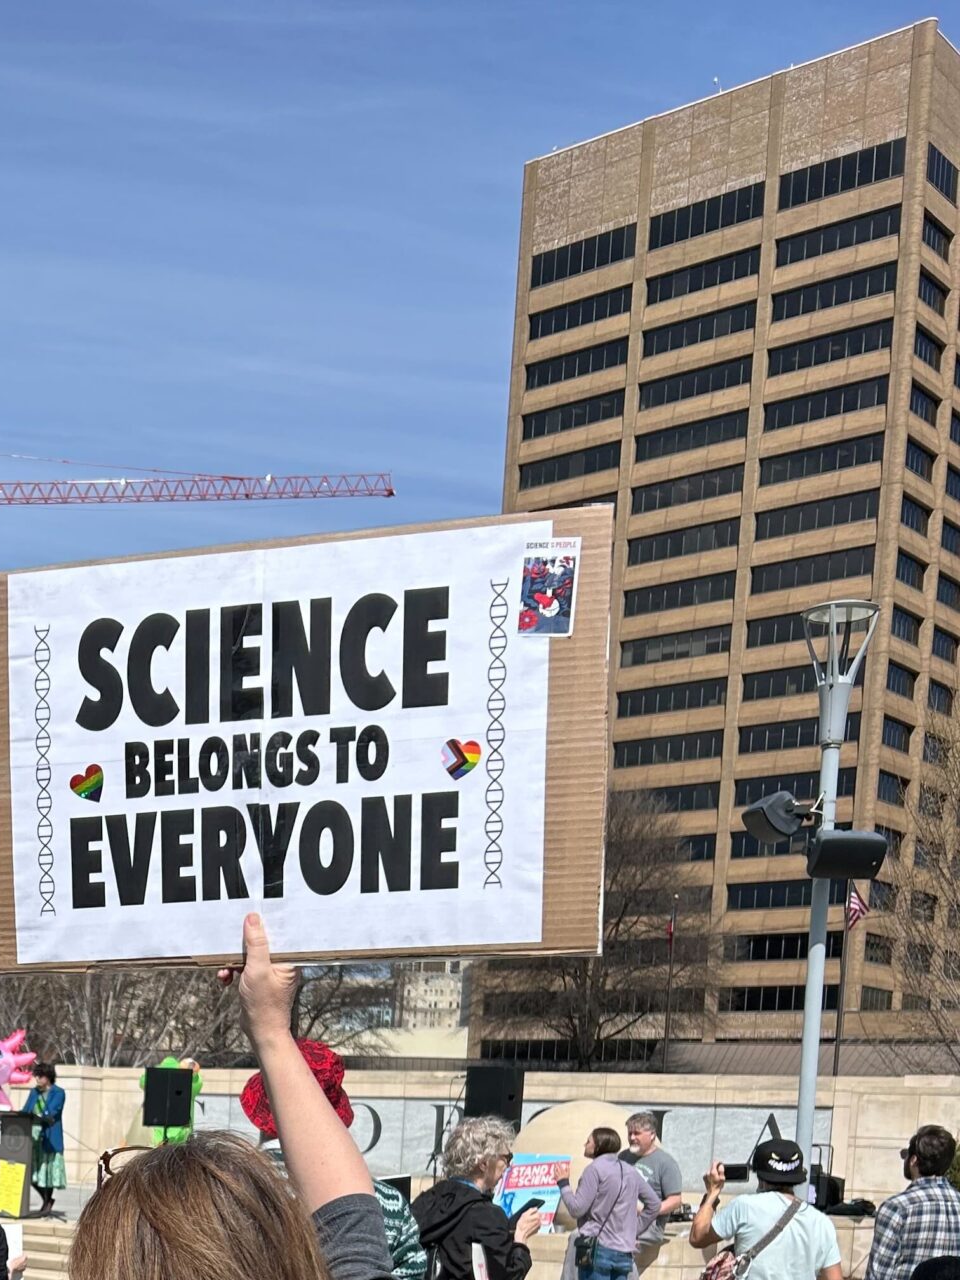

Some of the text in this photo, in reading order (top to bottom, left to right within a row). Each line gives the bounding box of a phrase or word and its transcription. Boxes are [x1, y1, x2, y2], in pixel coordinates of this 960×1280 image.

[76, 587, 449, 731] SCIENCE
[125, 725, 389, 798] BELONGS TO
[70, 791, 459, 908] EVERYONE
[511, 1164, 548, 1178] STAND
[518, 1174, 557, 1187] SCIENC
